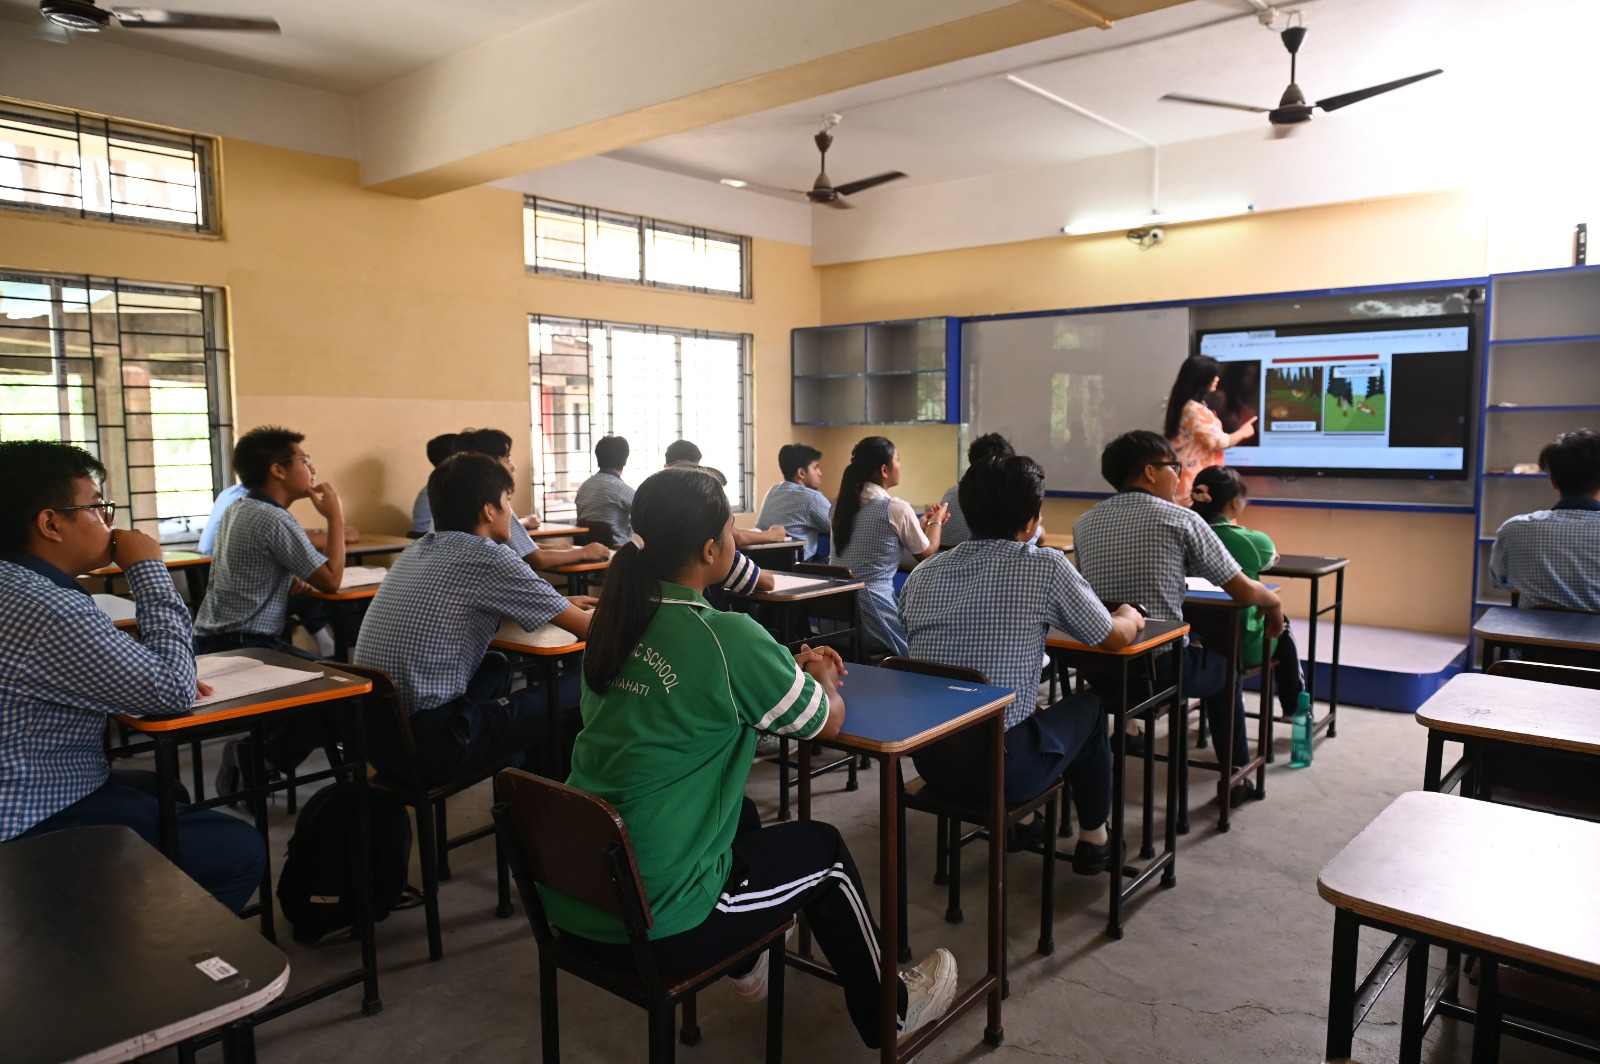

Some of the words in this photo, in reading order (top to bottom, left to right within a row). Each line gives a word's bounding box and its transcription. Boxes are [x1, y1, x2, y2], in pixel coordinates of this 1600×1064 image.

[609, 676, 650, 696] WAHATI
[630, 643, 643, 657] IC
[643, 647, 679, 694] SCHOOL
